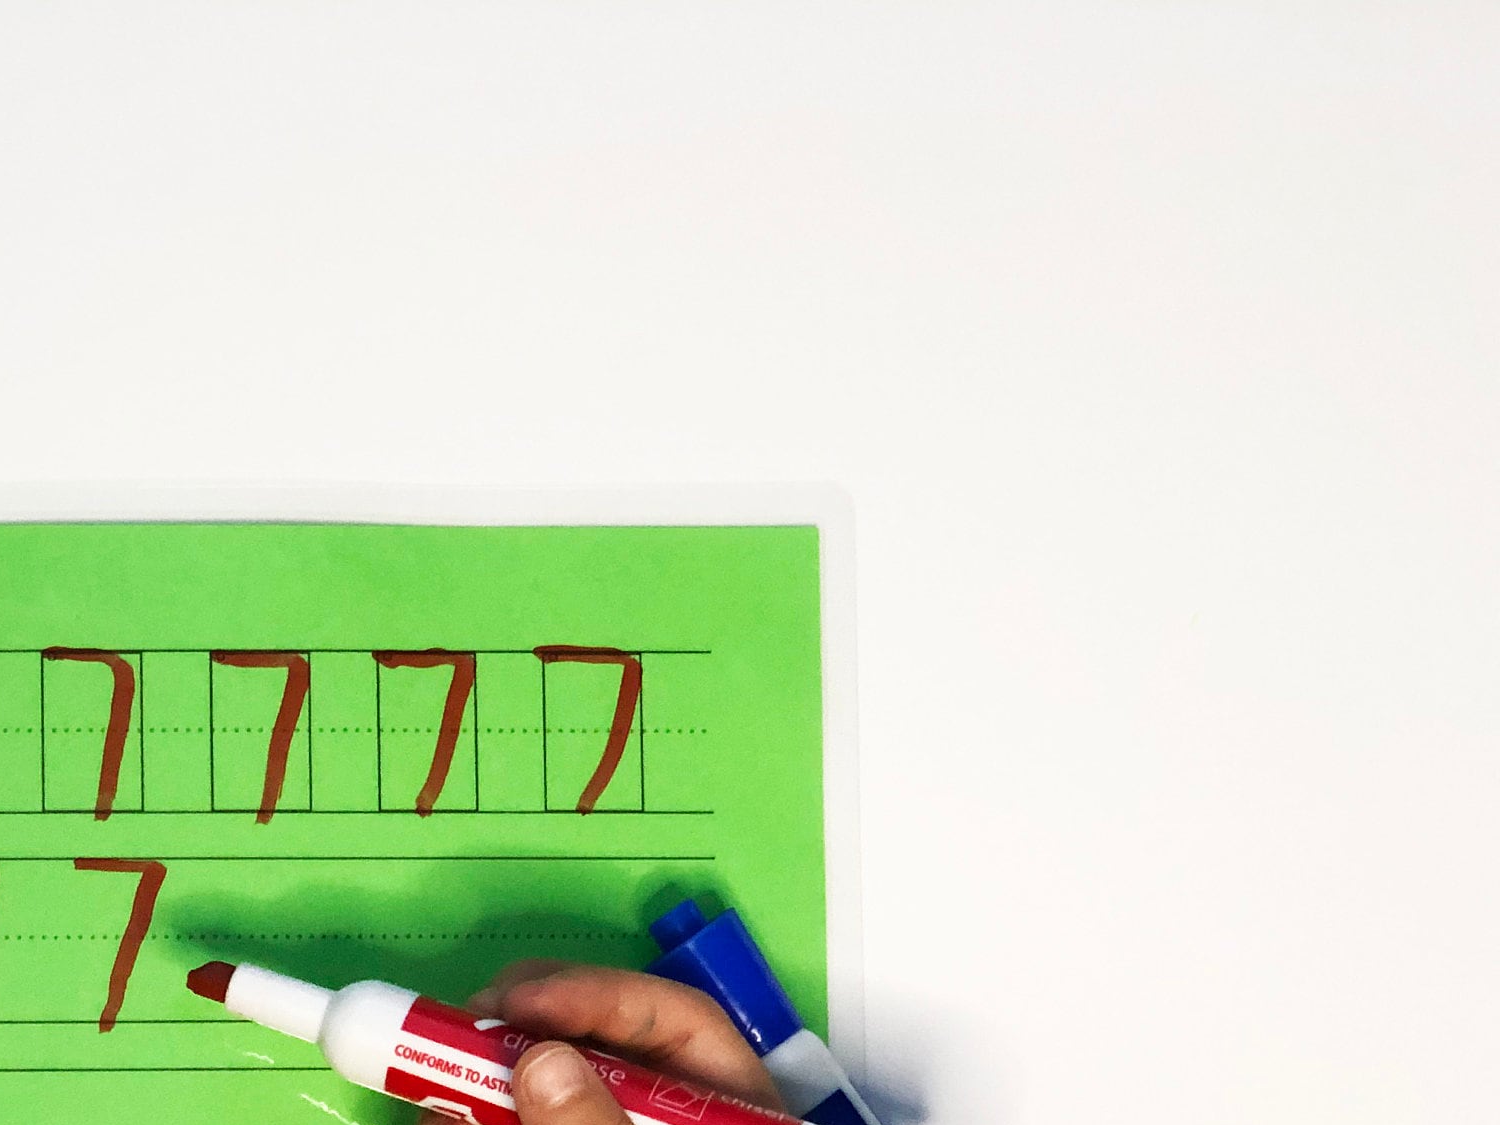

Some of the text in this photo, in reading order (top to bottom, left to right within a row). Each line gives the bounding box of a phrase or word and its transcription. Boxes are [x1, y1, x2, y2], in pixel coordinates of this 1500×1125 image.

[41, 646, 134, 821] 7
[210, 650, 310, 824] 7
[372, 647, 476, 818] 7
[533, 645, 641, 815] 7
[73, 857, 167, 1033] 7
[394, 1044, 463, 1079] CONFORMS
[465, 1068, 481, 1084] TO
